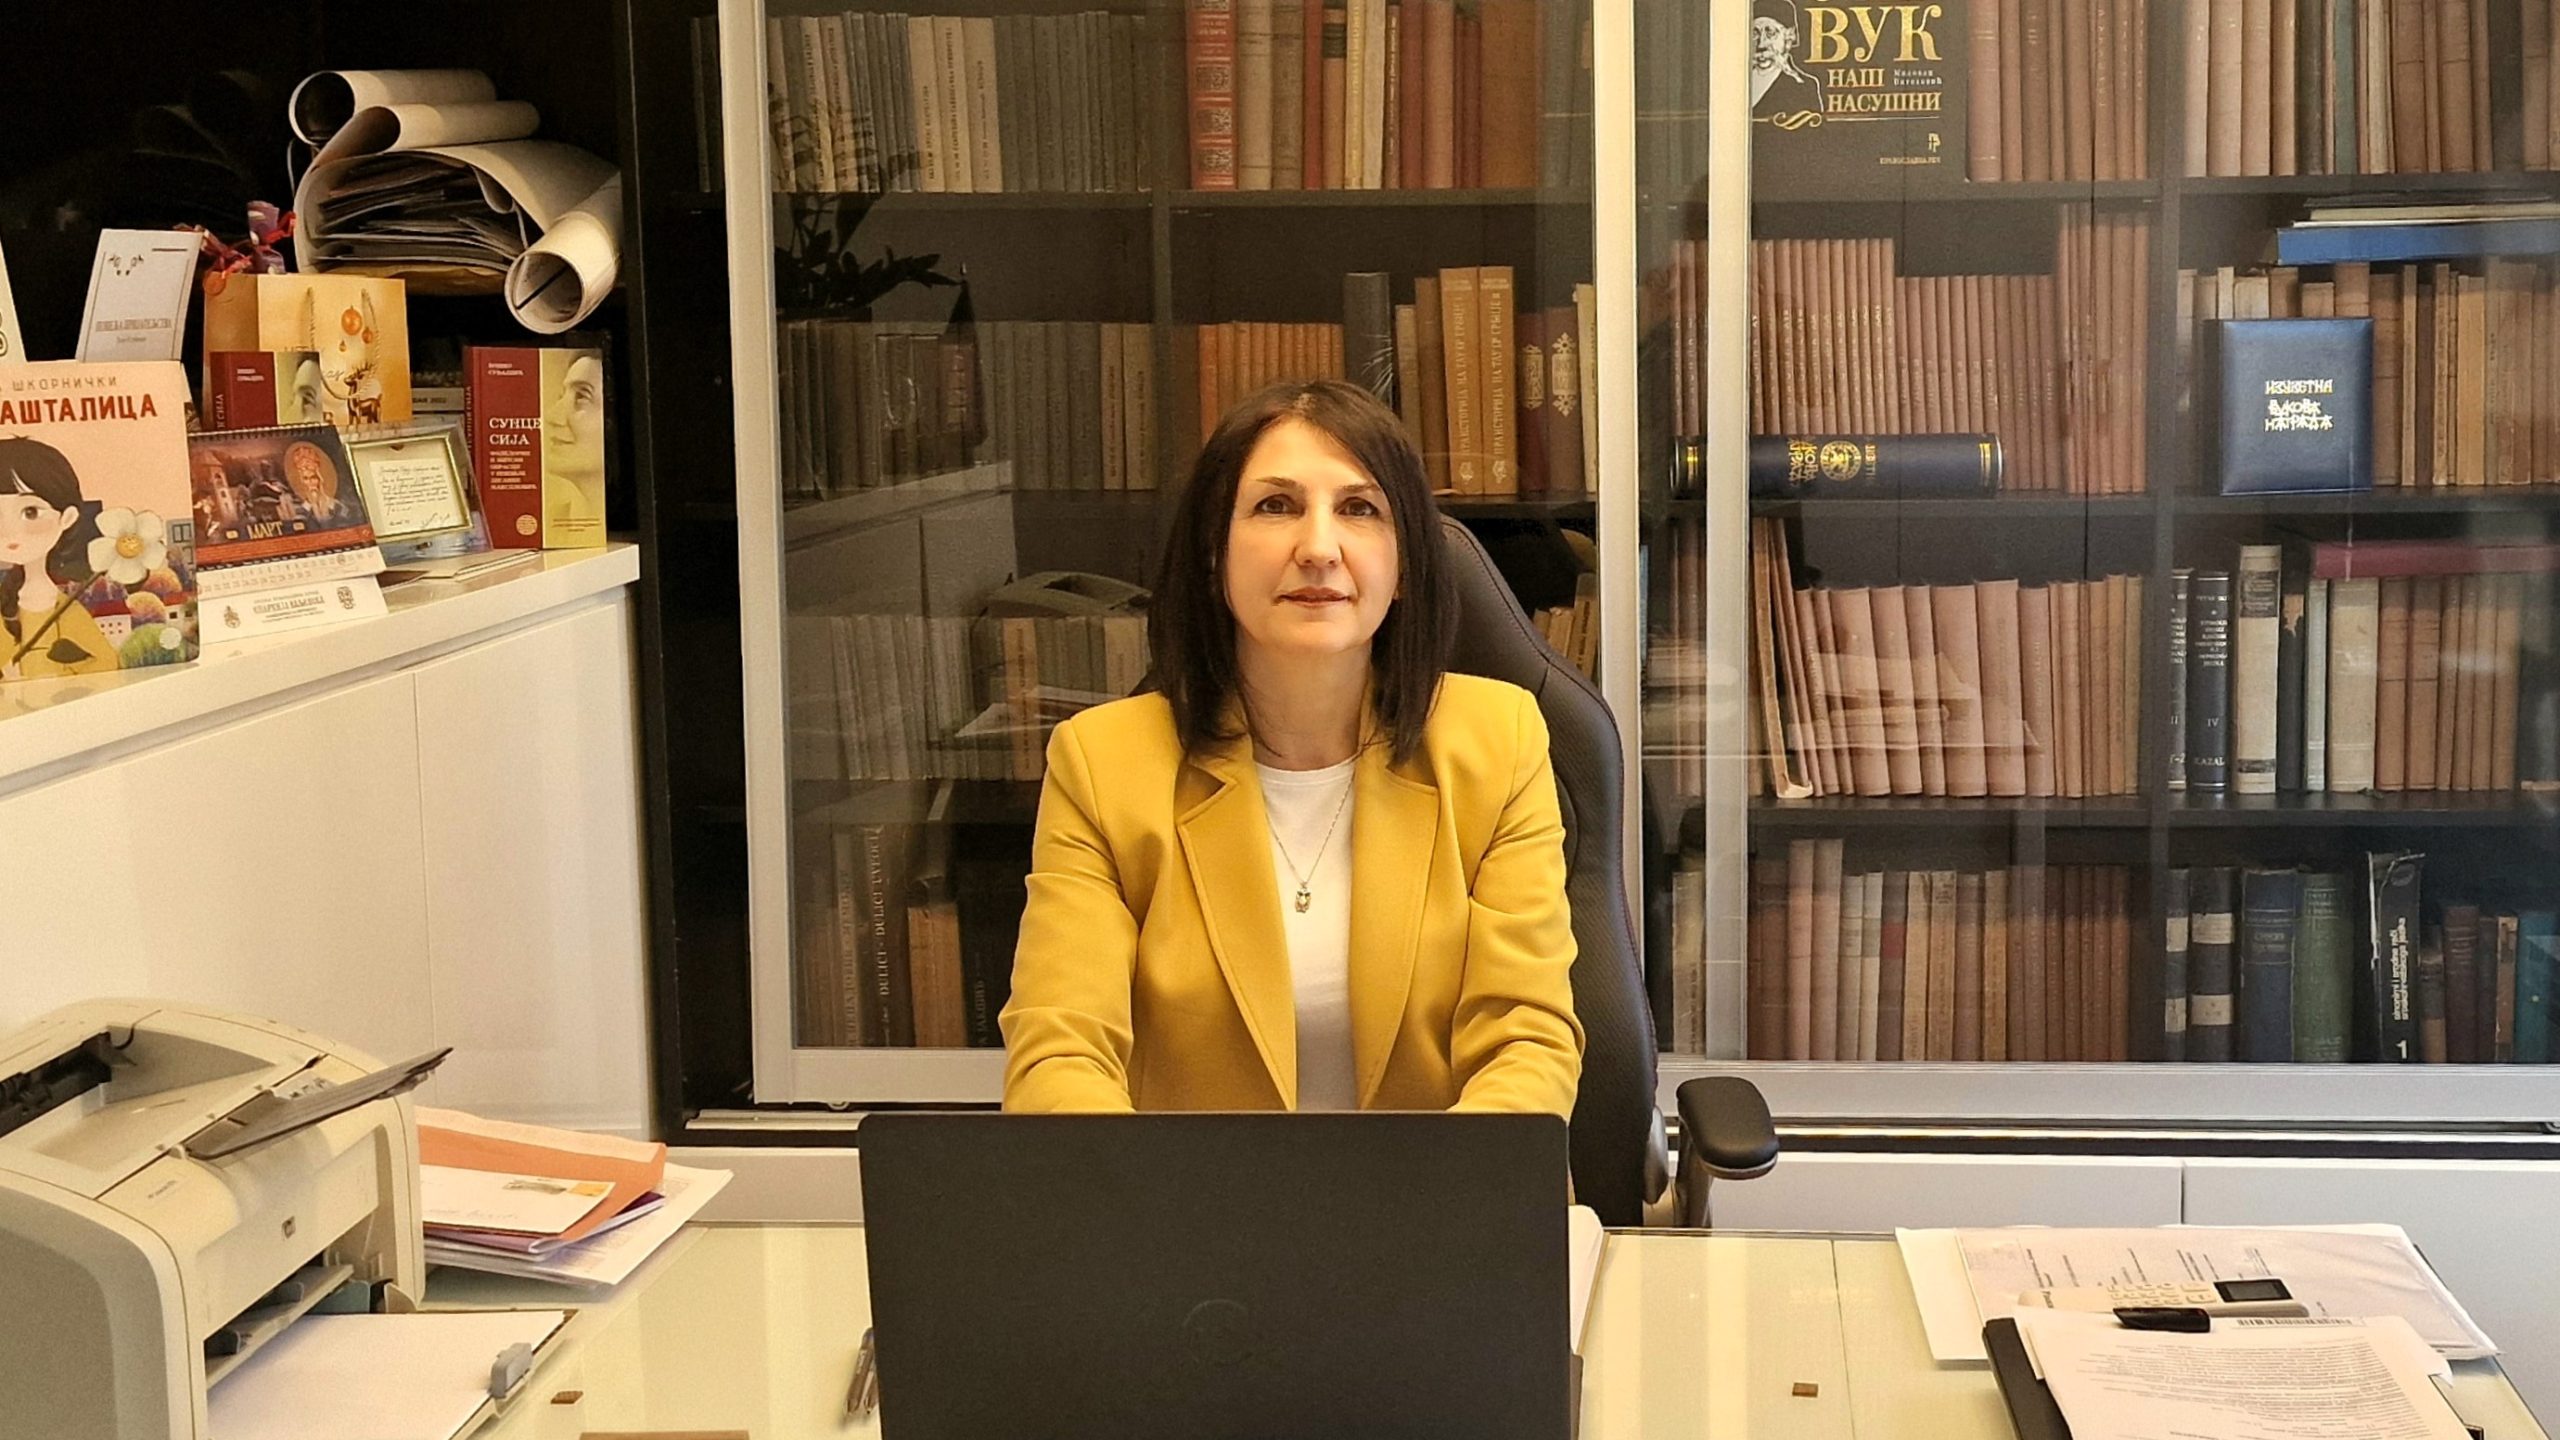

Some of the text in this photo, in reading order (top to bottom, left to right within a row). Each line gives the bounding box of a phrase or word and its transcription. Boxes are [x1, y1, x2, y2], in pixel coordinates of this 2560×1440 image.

[1804, 4, 1943, 63] ВУК
[1827, 68, 1885, 88] НАШ
[1827, 92, 1942, 112] НАСУШНИ
[12, 376, 117, 391] ШКОРНИЧКИ
[489, 417, 542, 431] СУНЦЕ
[489, 434, 531, 445] СИЈА
[247, 520, 283, 540] МАРТ
[2207, 717, 2220, 727] IV
[2395, 1040, 2407, 1060] 1
